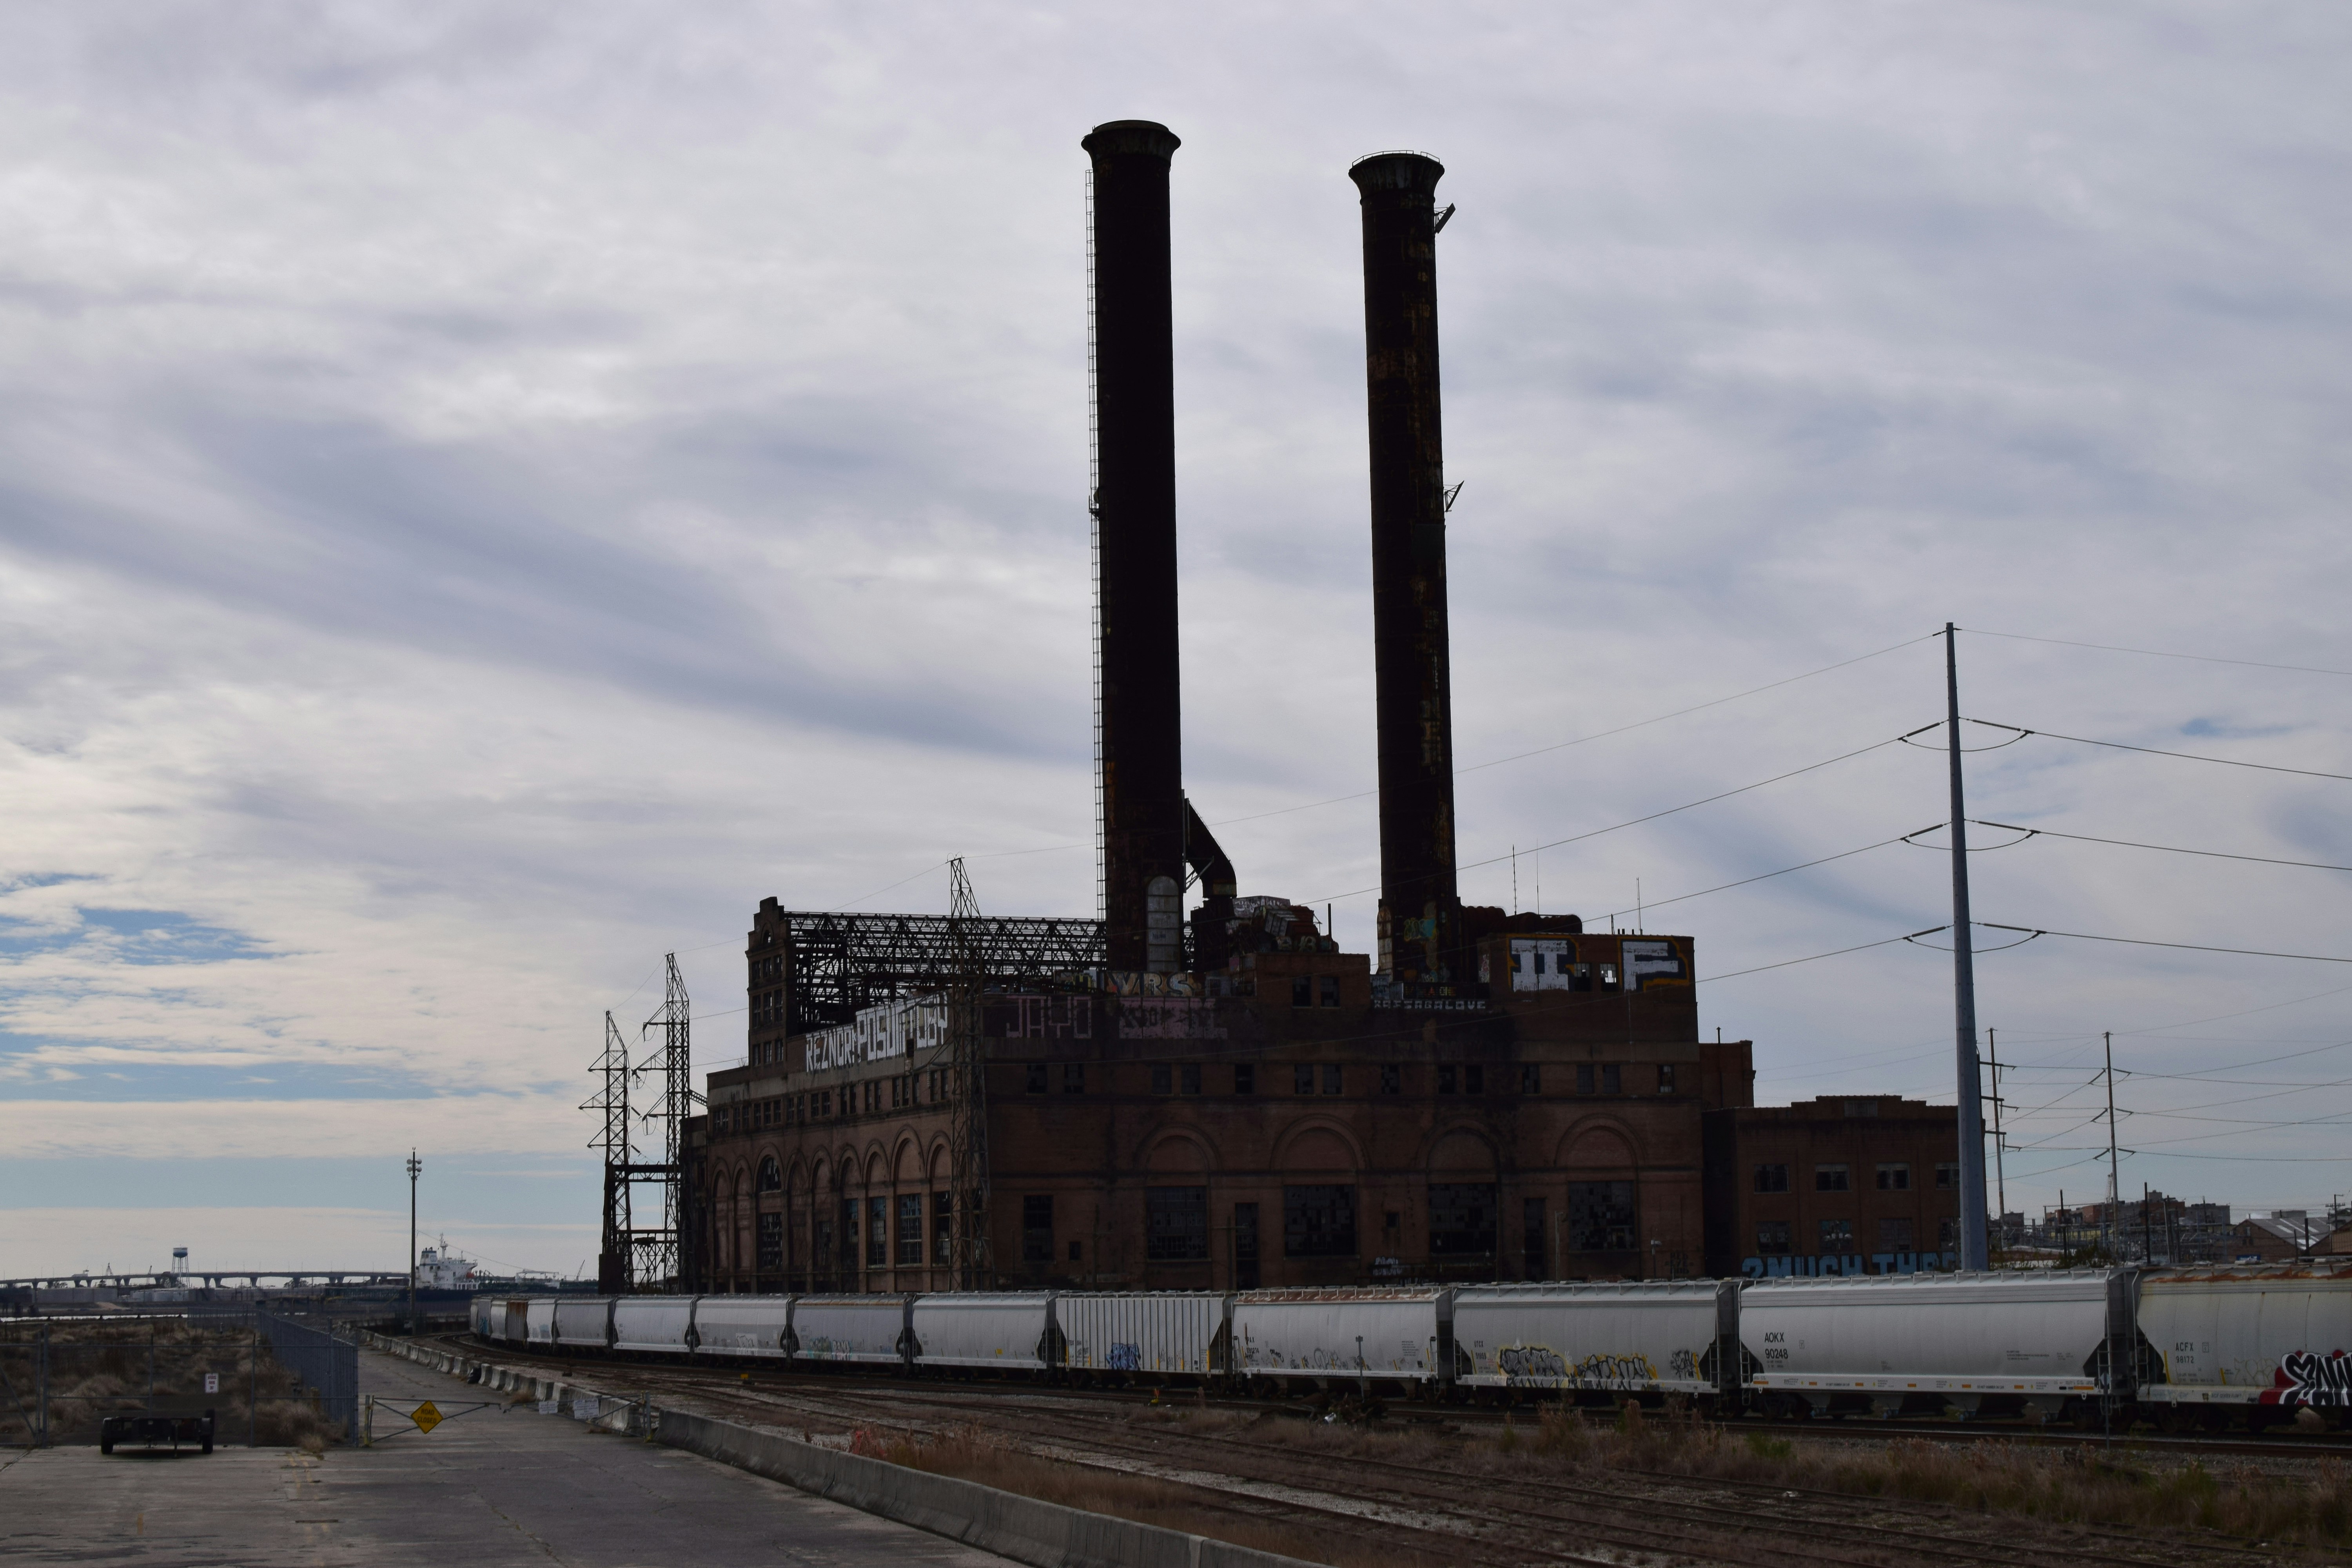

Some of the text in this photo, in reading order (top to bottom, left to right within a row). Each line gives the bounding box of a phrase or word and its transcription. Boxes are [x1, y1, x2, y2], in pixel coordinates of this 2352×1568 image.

[1764, 1332, 1784, 1343] AOKX
[2176, 1342, 2194, 1351] ACFX
[1765, 1348, 1788, 1359] 90248
